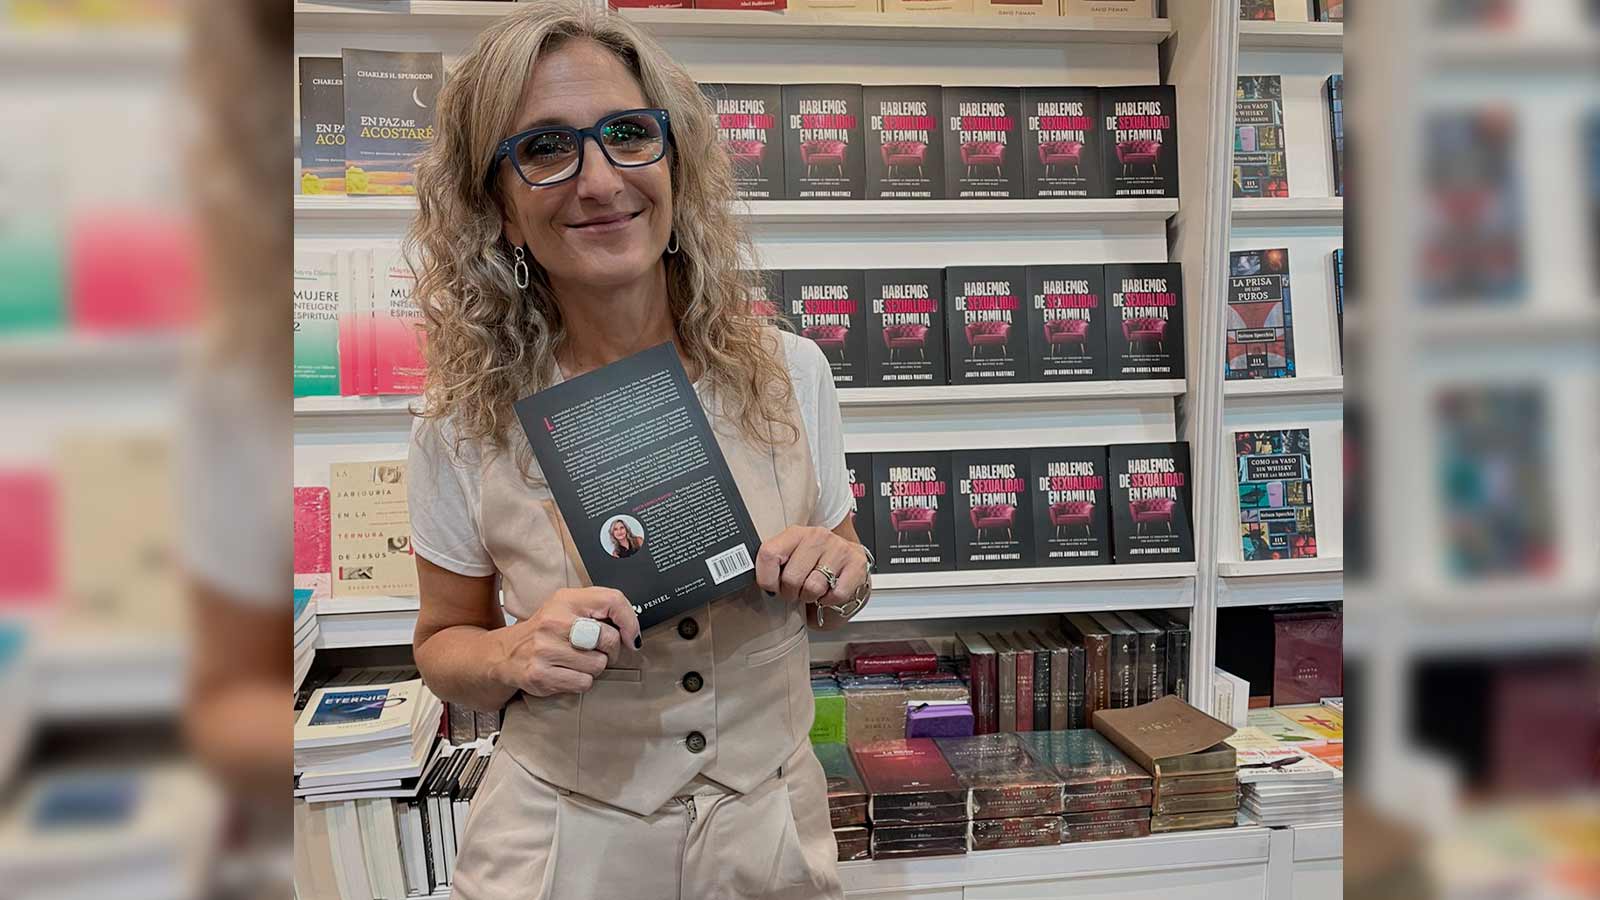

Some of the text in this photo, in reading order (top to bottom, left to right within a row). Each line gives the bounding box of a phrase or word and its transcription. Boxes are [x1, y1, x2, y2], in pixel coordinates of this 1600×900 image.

[717, 100, 764, 113] HABLEMOS
[800, 100, 846, 113] HABLEMOS
[881, 102, 927, 116] HABLEMOS
[960, 103, 1005, 116] HABLEMOS
[1038, 103, 1083, 116] HABLEMOS
[1115, 102, 1161, 115] HABLEMOS
[316, 124, 333, 132] EN
[361, 117, 376, 126] EN
[791, 115, 801, 129] DE
[872, 117, 882, 130] DE
[951, 117, 961, 131] DE
[1029, 116, 1039, 130] DE
[1107, 116, 1117, 130] DE
[361, 125, 434, 138] ACOSTARÉ
[718, 129, 767, 143] EN FAMILIA
[800, 129, 848, 143] EN FAMILIA
[881, 130, 928, 144] EN FAMILIA
[960, 131, 1007, 144] EN FAMILIA
[1038, 130, 1084, 144] EN FAMILIA
[1116, 129, 1162, 143] EN FAMILIA
[965, 282, 1010, 296] HABLEMOS
[1044, 280, 1088, 294] HABLEMOS
[1122, 279, 1167, 293] HABLEMOS
[1246, 278, 1272, 286] PRISA
[802, 285, 848, 300] HABLEMOS
[882, 285, 928, 298] HABLEMOS
[1238, 292, 1268, 300] PUROS
[793, 300, 803, 314] DE
[873, 300, 884, 313] DE
[955, 296, 966, 310] DE
[1035, 294, 1098, 309] DE SEXUALIDAD
[1113, 293, 1176, 307] DE SEXUALIDAD
[882, 313, 930, 326] EN FAMILIA
[965, 310, 1012, 323] EN FAMILIA
[1044, 308, 1090, 322] EN FAMILIA
[1122, 306, 1168, 320] EN FAMILIA
[802, 314, 850, 327] EN FAMILIA
[969, 464, 1015, 479] HABLEMOS
[1048, 462, 1093, 476] HABLEMOS
[1128, 459, 1174, 473] HABLEMOS
[889, 467, 936, 482] HABLEMOS
[1119, 473, 1184, 488] DE SEXUALIDAD
[881, 481, 945, 496] DE SEXUALIDAD
[961, 479, 1024, 494] DE SEXUALIDAD
[1040, 476, 1103, 490] DE SEXUALIDAD
[970, 493, 1017, 507] EN FAMILIA
[1049, 491, 1095, 504] EN FAMILIA
[1129, 488, 1176, 501] EN FAMILIA
[890, 496, 938, 510] EN FAMILIA
[644, 594, 670, 609] PENIEL
